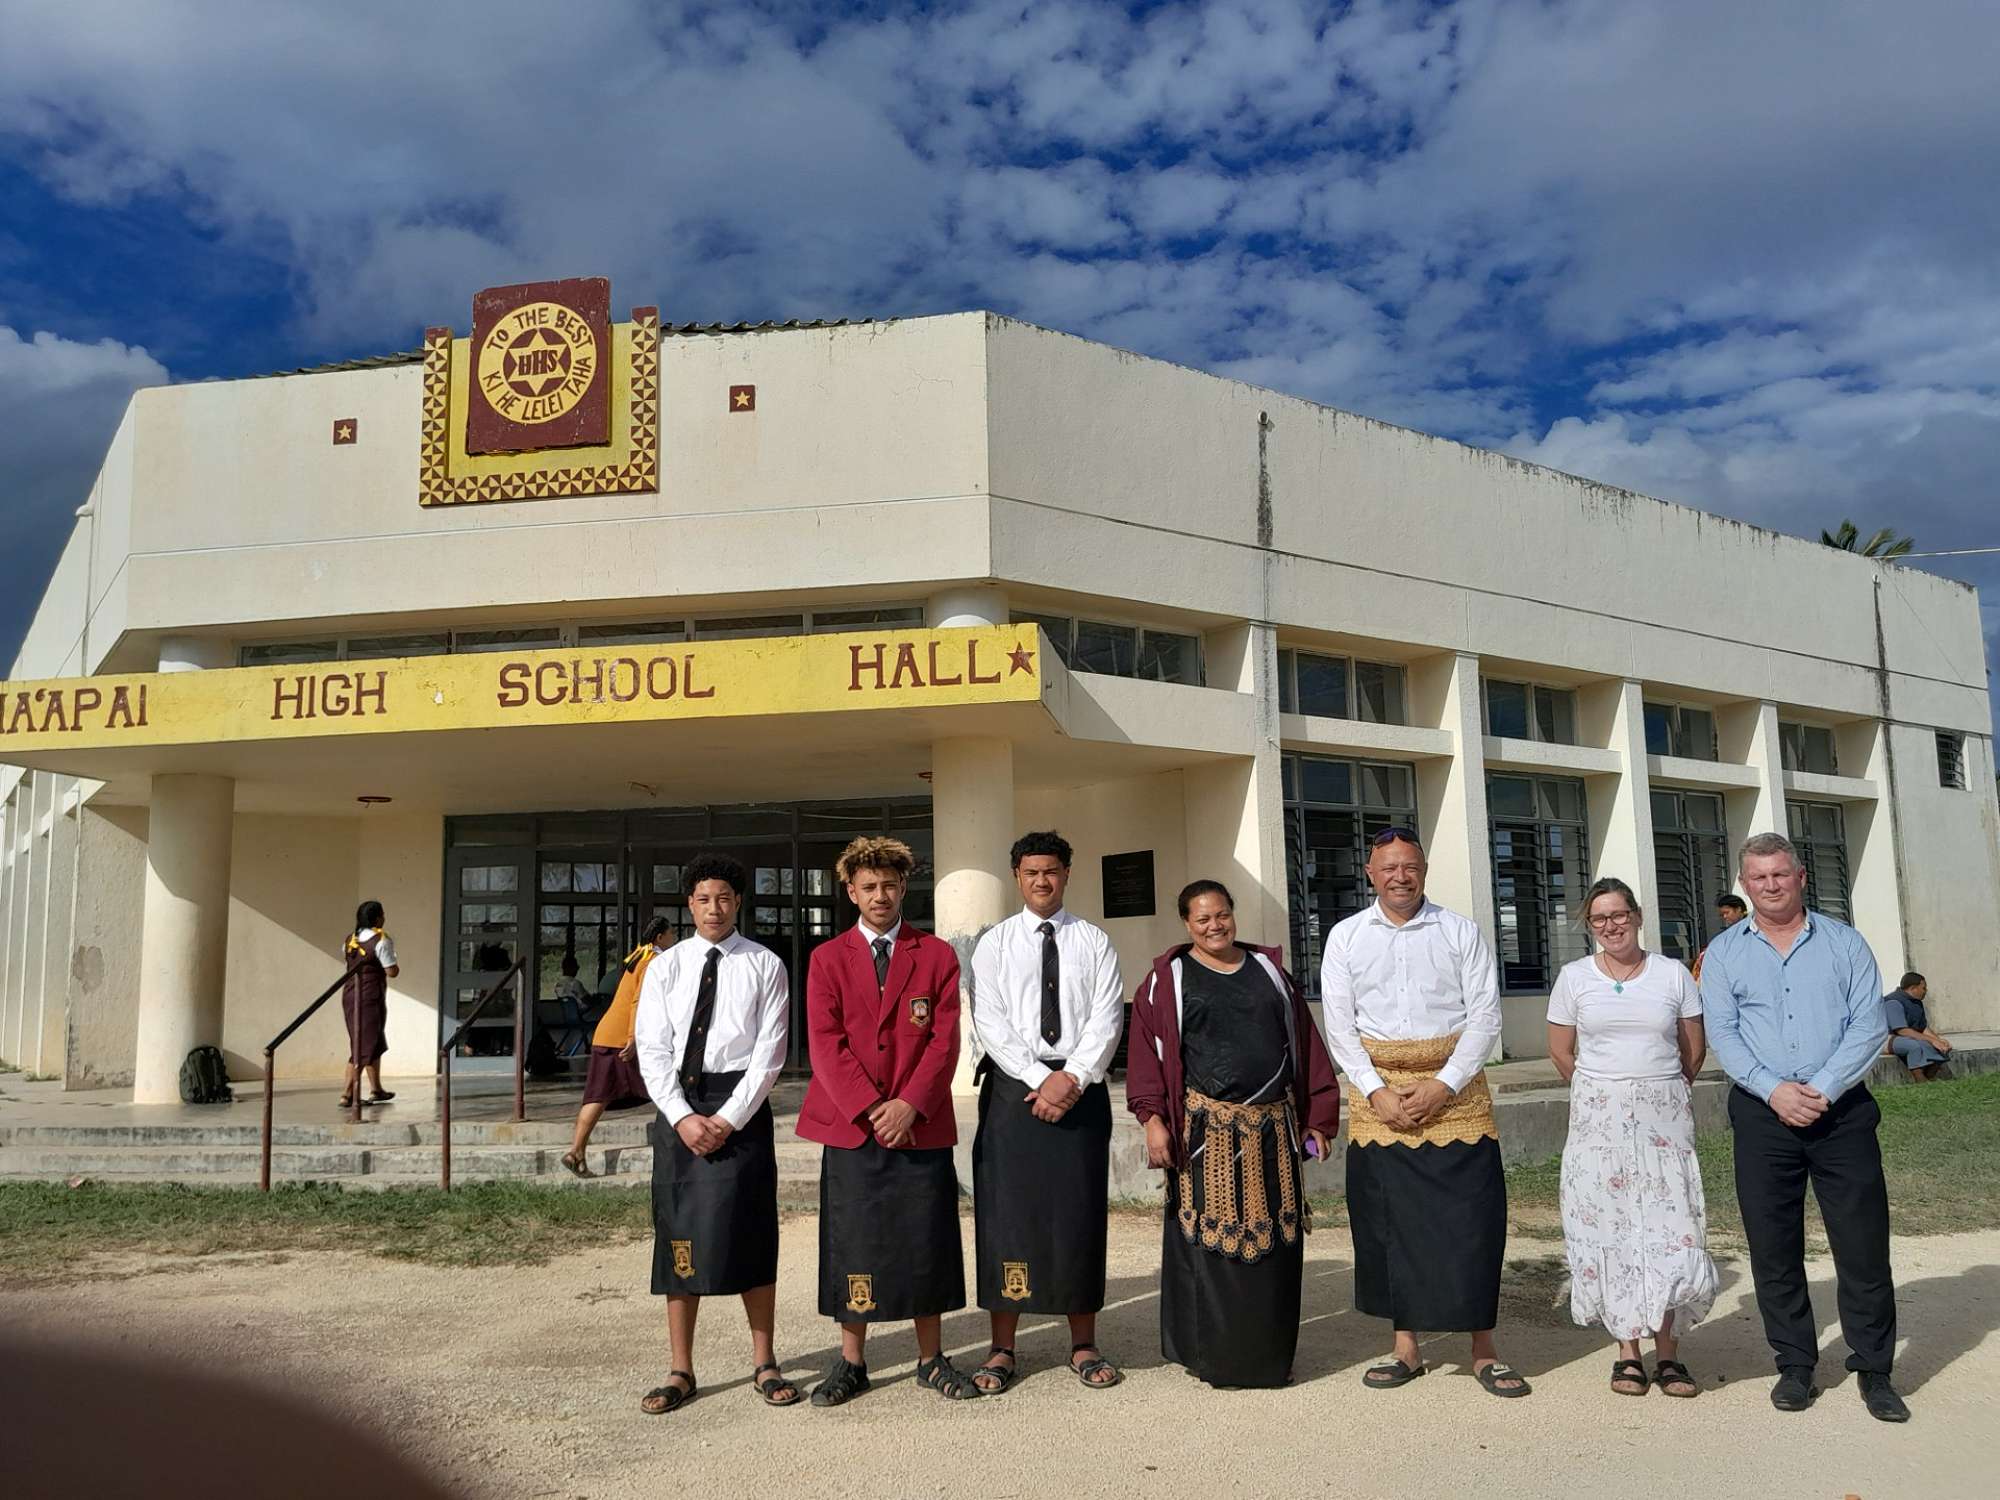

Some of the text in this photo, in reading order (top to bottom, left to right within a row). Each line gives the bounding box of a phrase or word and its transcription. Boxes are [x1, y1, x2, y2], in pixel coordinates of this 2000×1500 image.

[487, 307, 593, 349] TO THE BEST
[483, 356, 592, 420] KI HE LELEI TAHA
[518, 350, 558, 376] HHS
[270, 671, 388, 720] HIGH
[497, 654, 715, 708] SCHOOL
[848, 639, 1001, 691] HALL
